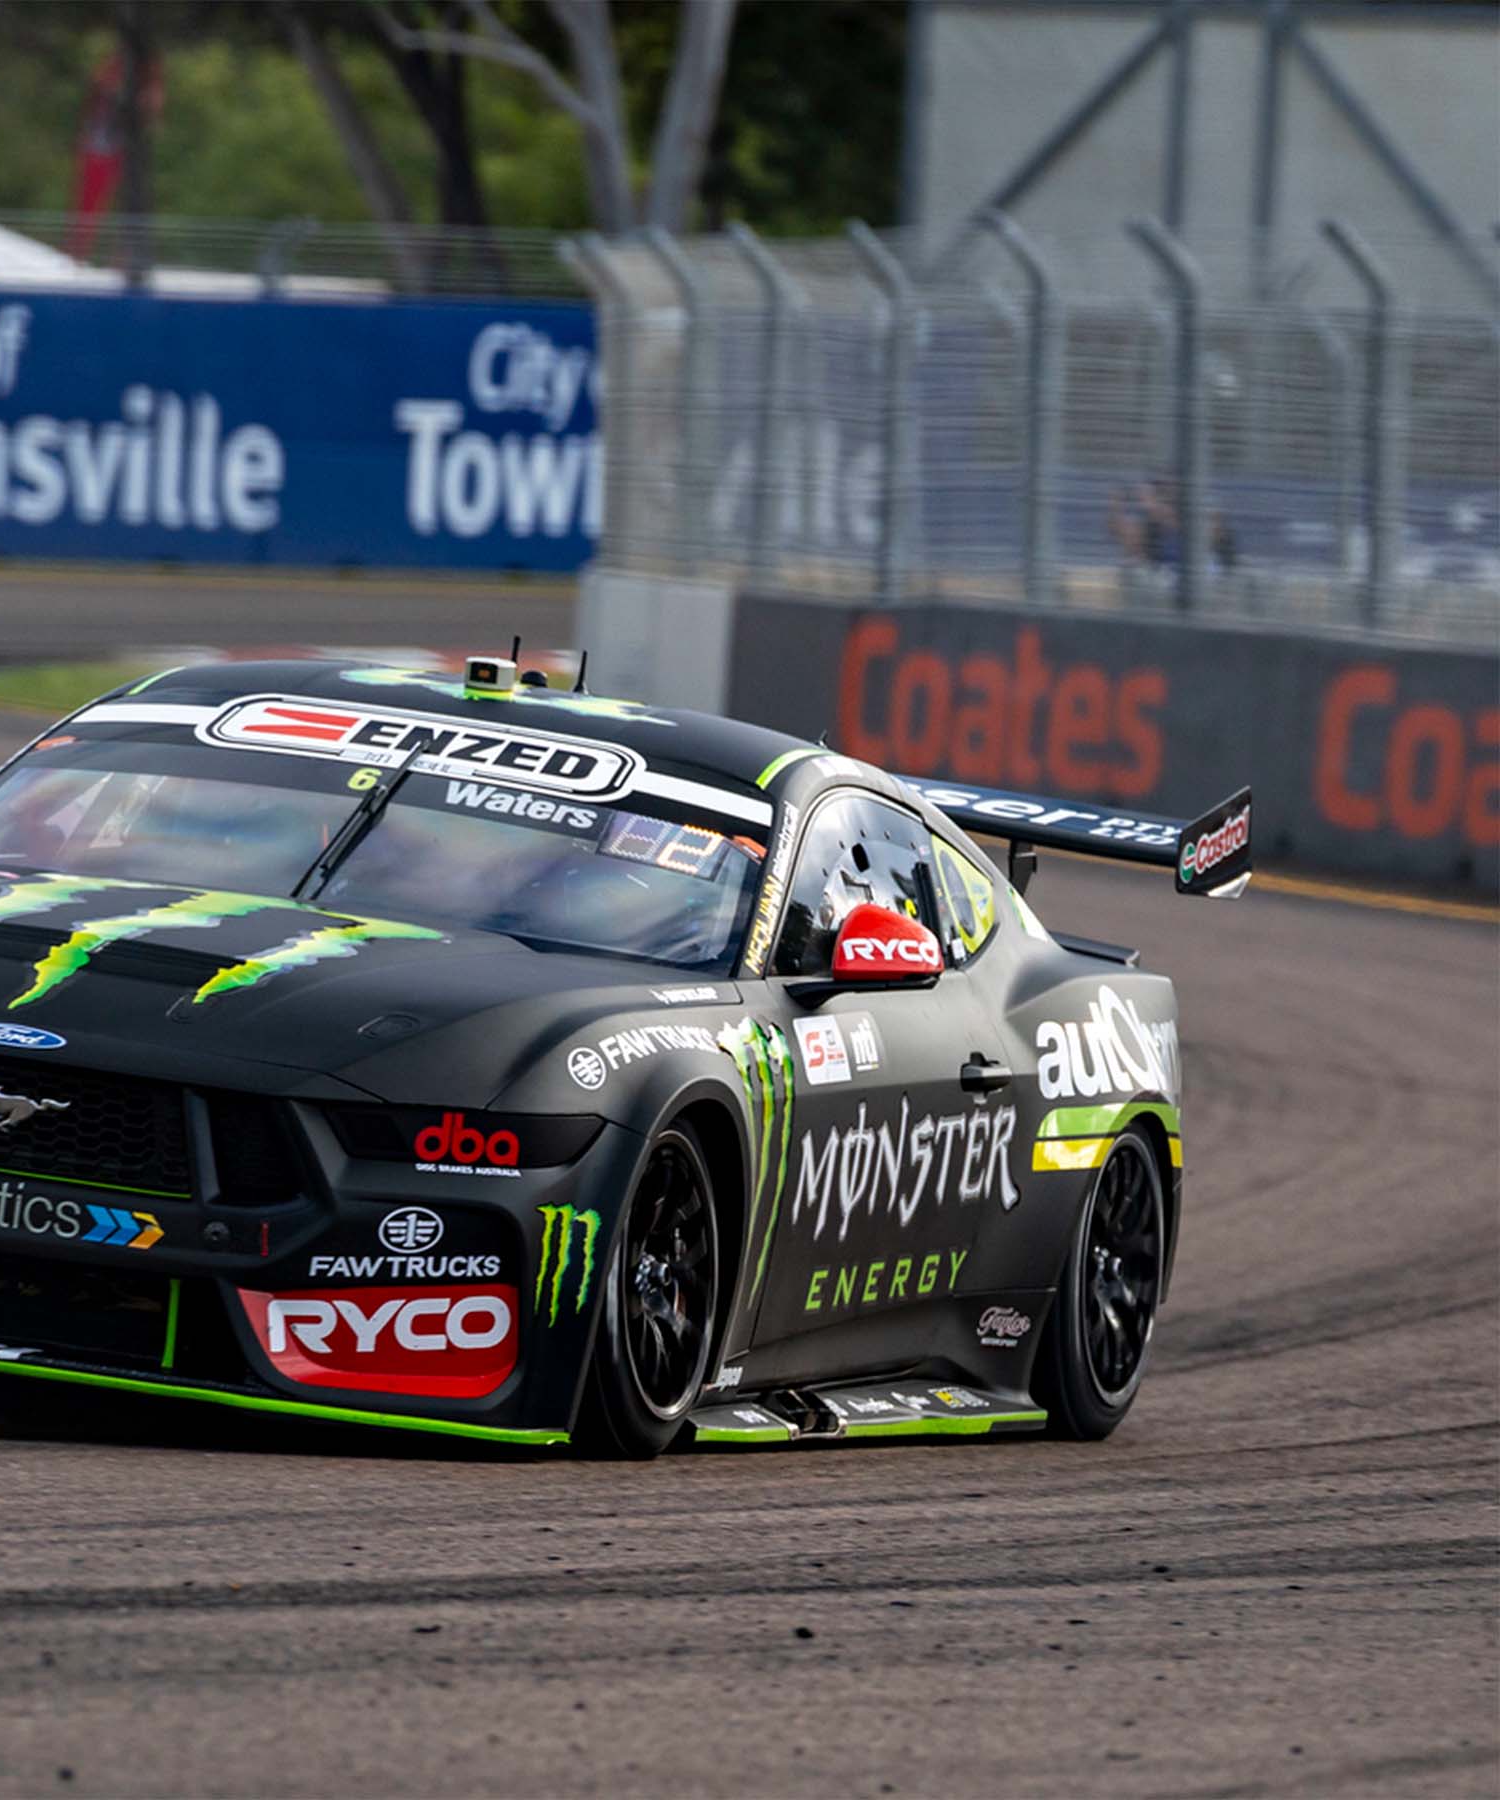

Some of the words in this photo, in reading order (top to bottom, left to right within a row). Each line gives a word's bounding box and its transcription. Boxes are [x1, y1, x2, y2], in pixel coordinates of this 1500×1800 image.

[468, 321, 590, 431] City
[838, 613, 1168, 797] Coates
[349, 720, 599, 779] ENZED
[347, 768, 382, 791] 6
[908, 782, 1099, 826] ser
[445, 780, 598, 829] Waters
[1100, 817, 1183, 836] PTY
[1088, 827, 1176, 846] LTD
[1195, 805, 1250, 874] Castrol
[842, 938, 939, 966] RYCO
[598, 1028, 657, 1070] FAW
[414, 1111, 520, 1166] dba
[308, 1256, 385, 1278] FAW
[386, 1255, 501, 1278] TRUCKS
[805, 1250, 968, 1310] ENERGY
[267, 1295, 512, 1354] RYCO
